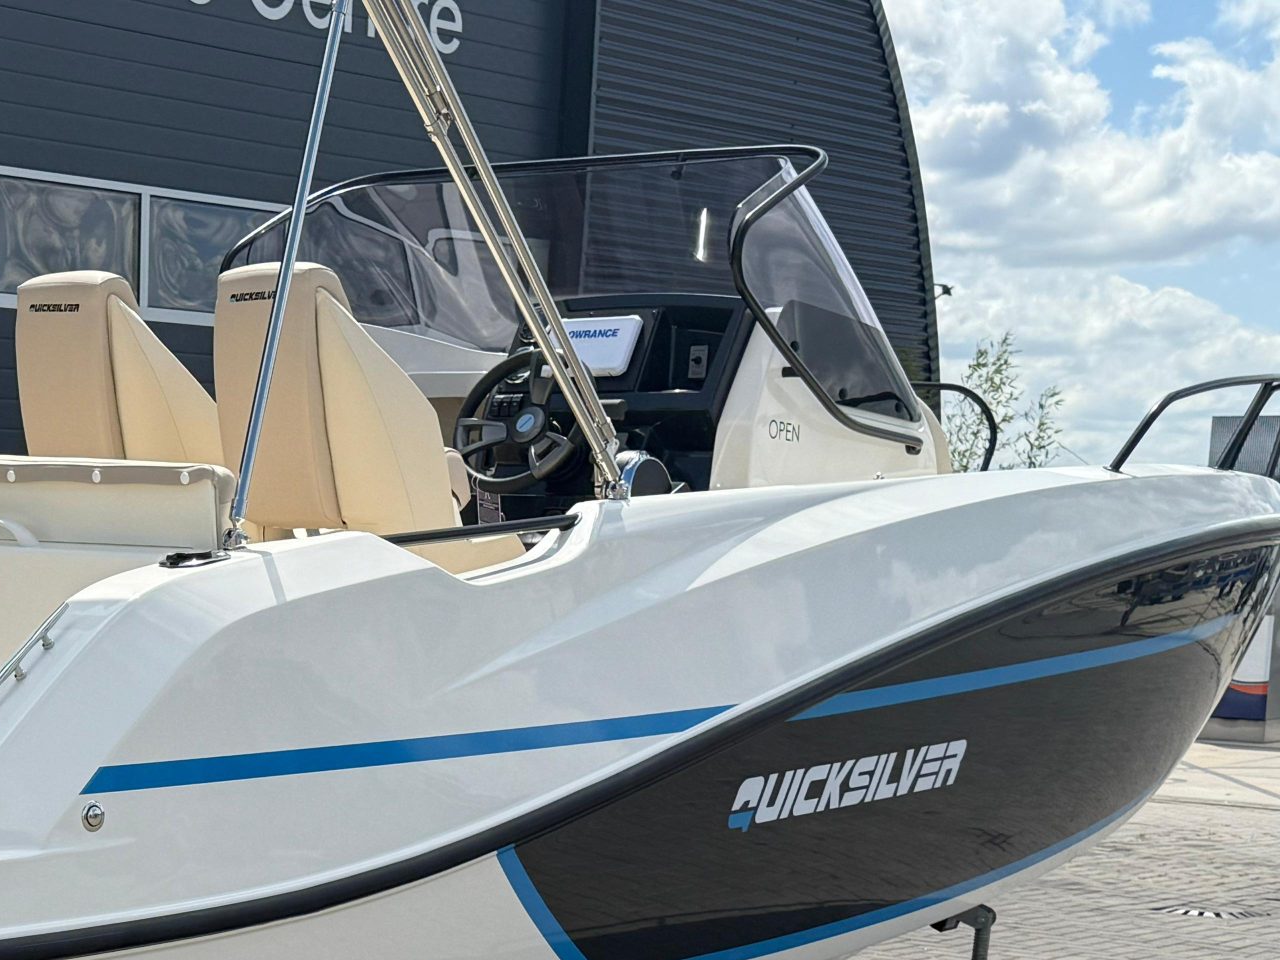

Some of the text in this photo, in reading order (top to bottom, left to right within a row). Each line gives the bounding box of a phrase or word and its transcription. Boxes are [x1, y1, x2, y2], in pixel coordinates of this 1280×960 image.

[29, 303, 80, 313] QUICKSILVER
[568, 328, 620, 339] OWRANCE
[769, 419, 800, 443] OPEN
[727, 739, 968, 832] QUICKSILVER
